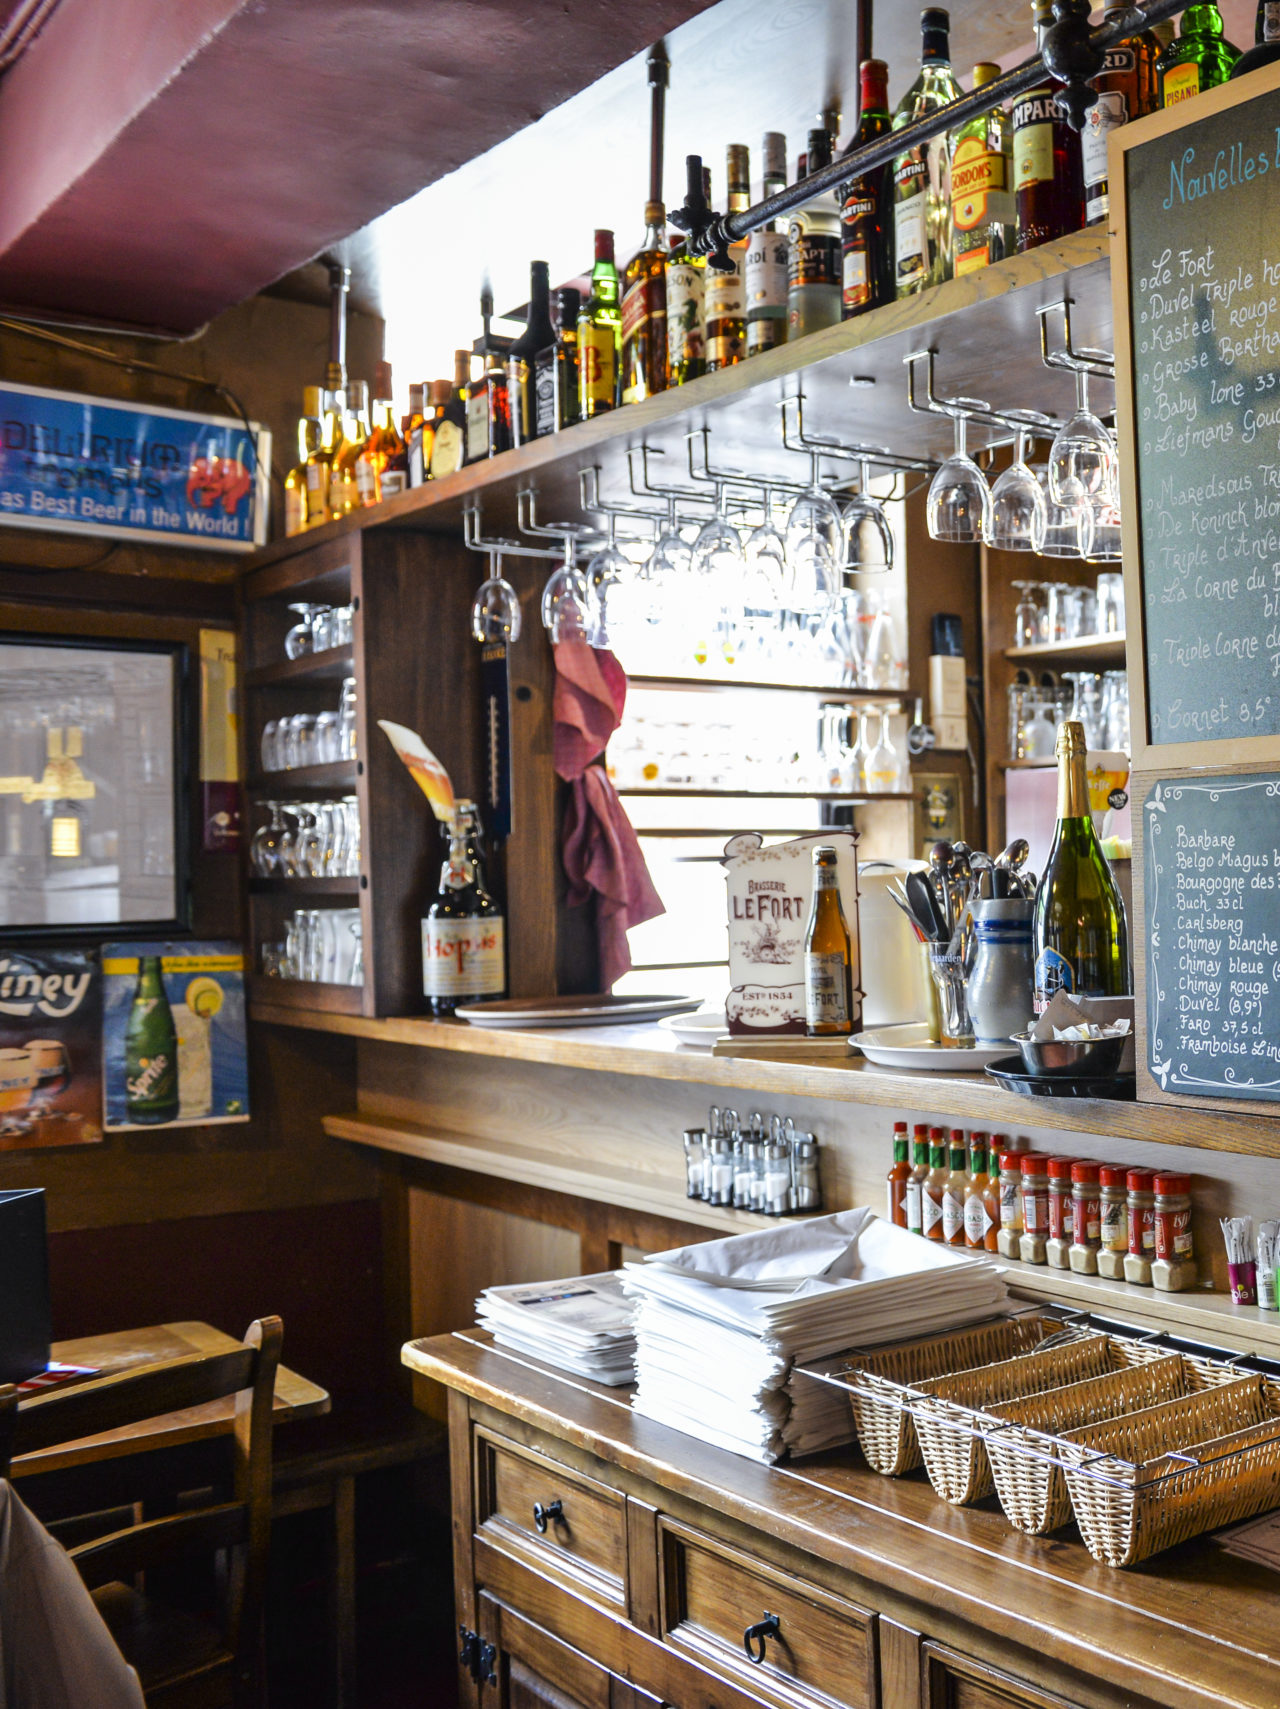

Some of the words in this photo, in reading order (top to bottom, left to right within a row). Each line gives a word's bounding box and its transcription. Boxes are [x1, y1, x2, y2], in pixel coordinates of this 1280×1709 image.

[1166, 85, 1198, 107] PISANG
[1163, 142, 1269, 209] Nouvelles
[1150, 249, 1172, 289] Le
[1150, 284, 1194, 321] Duvel
[1202, 267, 1253, 309] Triple
[1150, 312, 1216, 351] Kasteel
[1153, 351, 1209, 392] Grosse
[1154, 393, 1197, 421] Baby
[1155, 424, 1234, 456] Liefmans
[1157, 474, 1252, 509] Maredsous
[30, 491, 77, 514] Best
[81, 498, 124, 521] Beer
[130, 508, 146, 523] in
[152, 510, 181, 528] the
[186, 512, 239, 536] World
[1192, 499, 1247, 536] Koninck
[1161, 546, 1208, 579] Triple
[1161, 579, 1188, 604] La
[1247, 566, 1265, 590] du
[1168, 696, 1229, 731] Cornet
[1176, 825, 1235, 850] Barbare
[1176, 851, 1213, 874] Belgo
[1218, 851, 1268, 873] Magus
[1176, 873, 1245, 895] Bourgogne
[1251, 873, 1274, 889] des
[1177, 893, 1211, 912] Buch
[1178, 915, 1243, 936] Carlsberg
[1178, 936, 1221, 956] Chimay
[1229, 933, 1278, 955] blanche
[1179, 956, 1221, 977] Chimay
[1229, 957, 1264, 974] bleue
[0, 965, 91, 1017] iney
[1179, 977, 1221, 998] Chimay
[1180, 995, 1220, 1012] Duvel
[1180, 1014, 1210, 1035] Faro
[1180, 1035, 1247, 1057] Framboise
